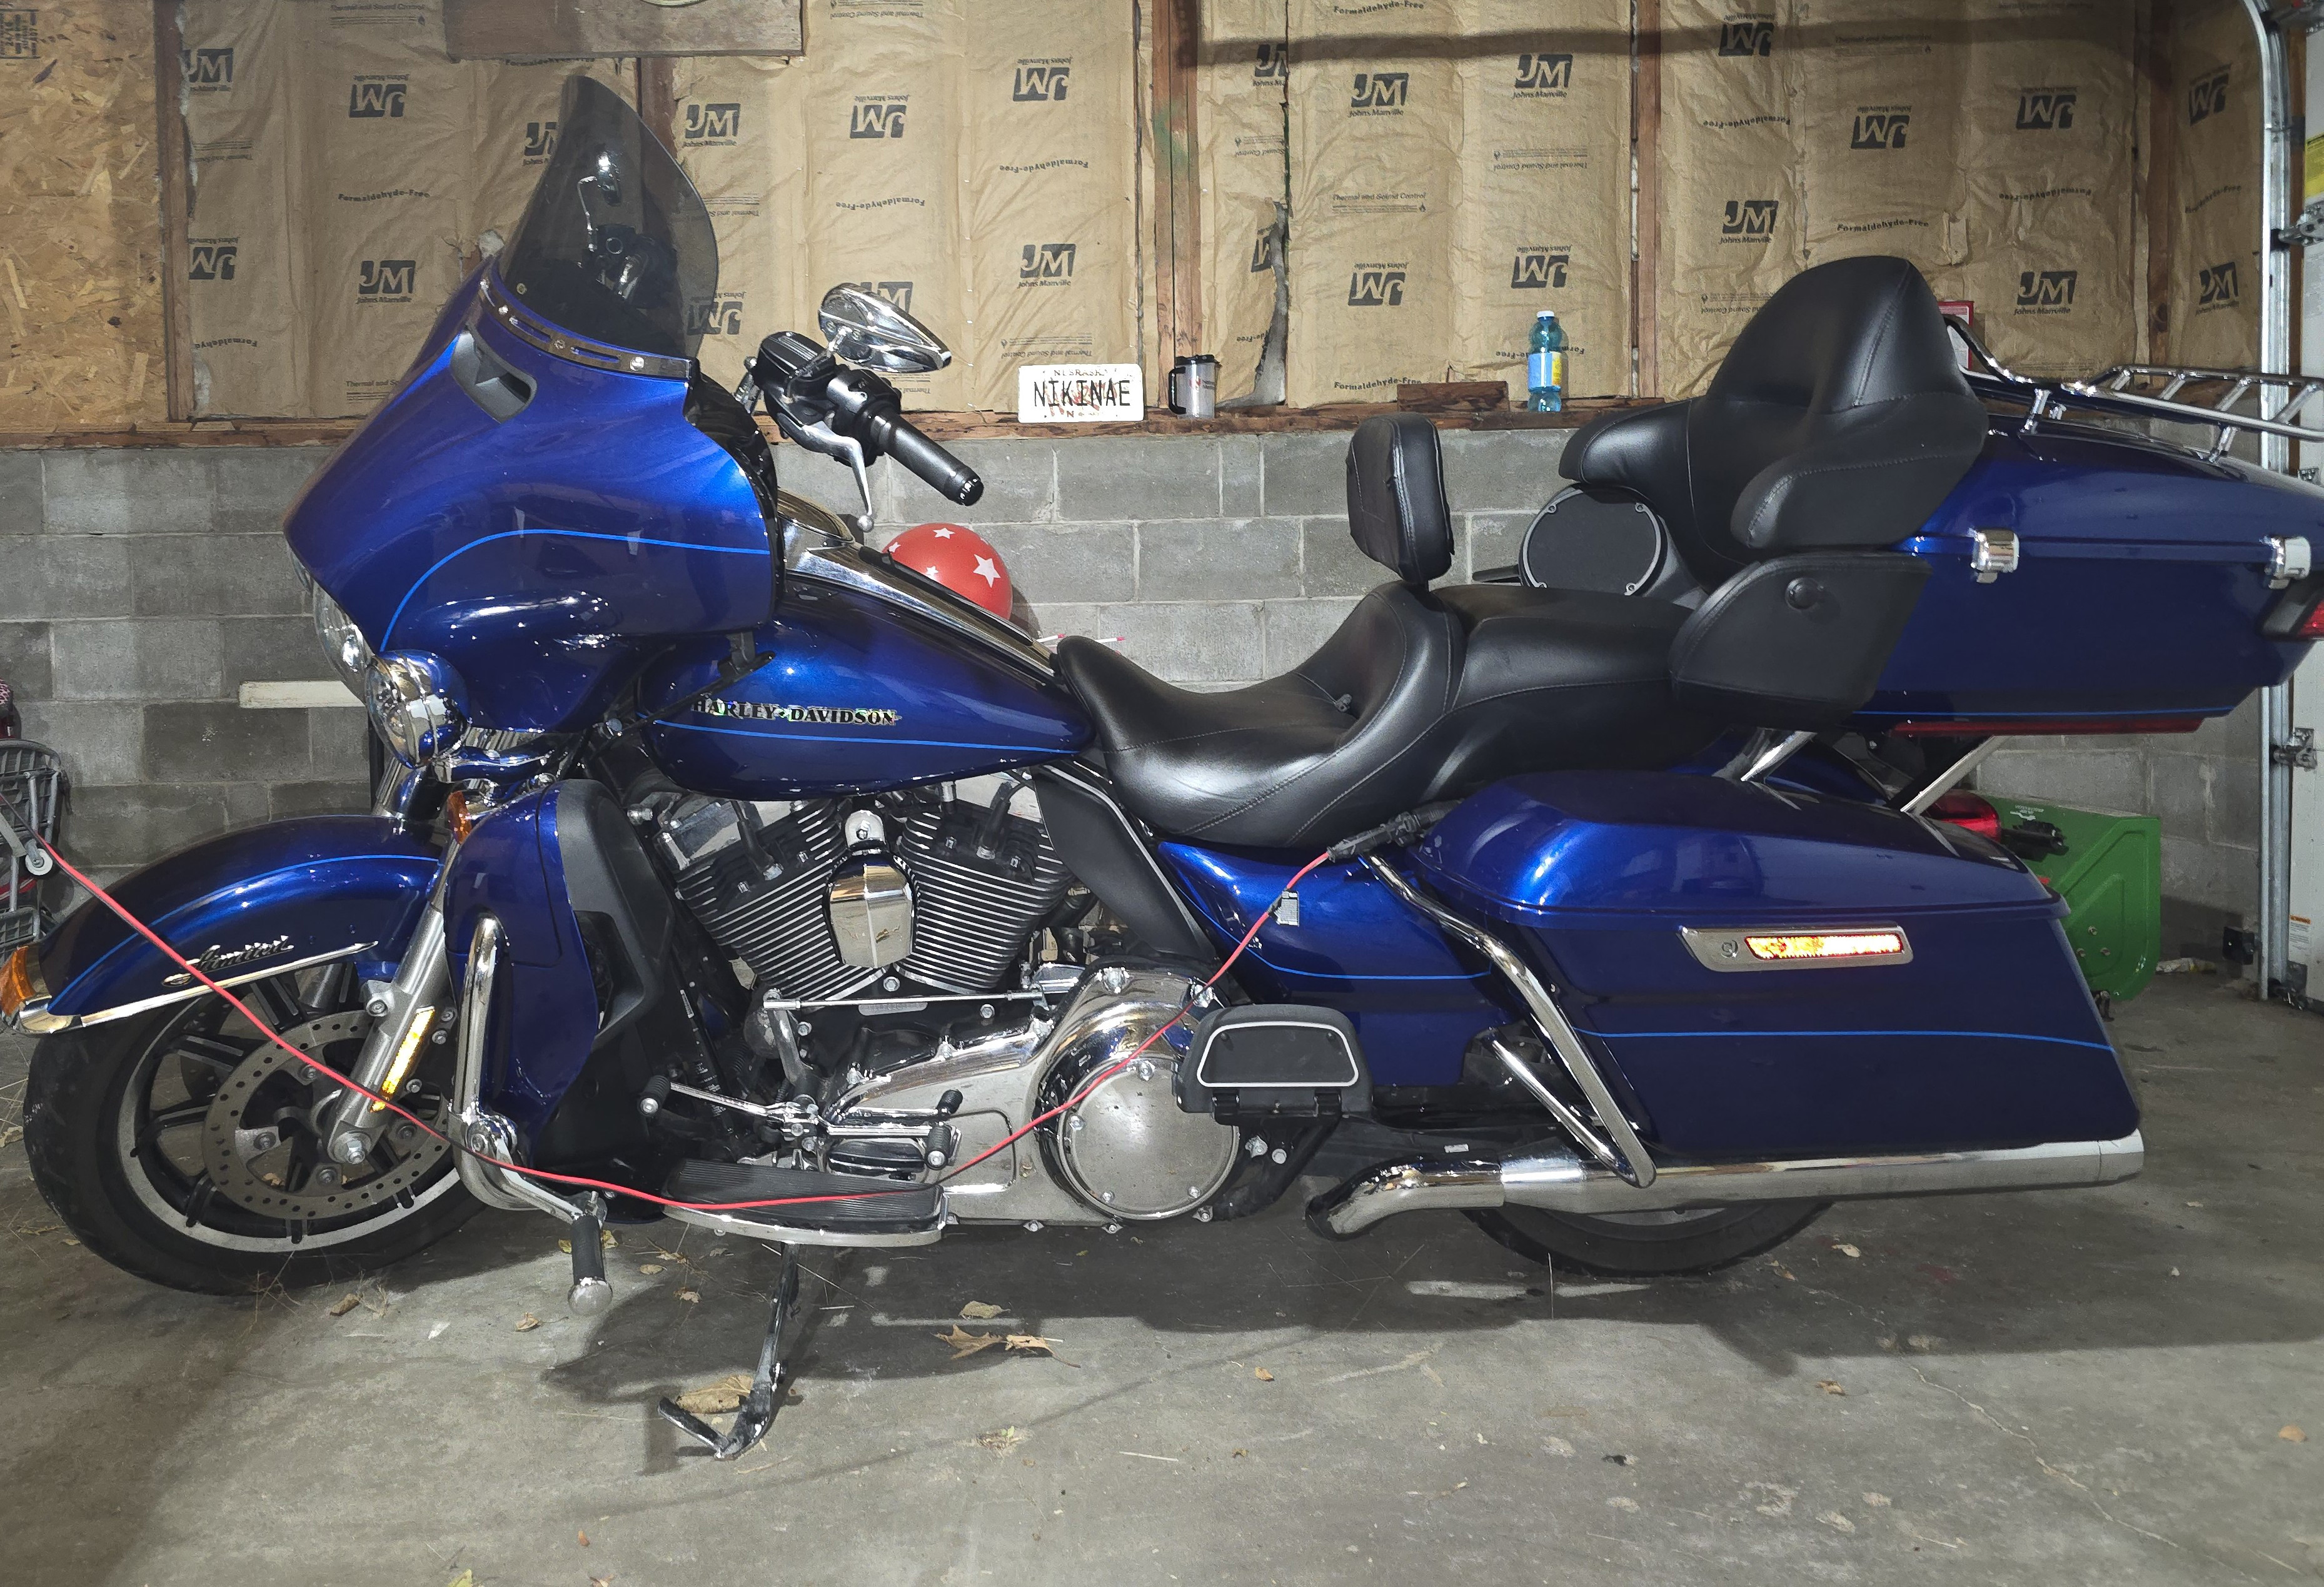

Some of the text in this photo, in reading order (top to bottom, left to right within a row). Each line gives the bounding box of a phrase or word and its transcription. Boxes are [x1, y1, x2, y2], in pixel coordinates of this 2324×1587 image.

[1718, 23, 1774, 56] JM
[1013, 68, 1071, 101] JM
[1515, 54, 1573, 89] JM
[349, 84, 407, 118] JM
[1351, 73, 1409, 108] JM
[685, 103, 740, 138] JM
[850, 104, 907, 139] JM
[2016, 94, 2076, 129] JM
[1850, 115, 1911, 149] JM
[1723, 201, 1779, 234] JM
[360, 260, 416, 295] JM
[1020, 243, 1077, 278] JM
[1511, 254, 1569, 288] JM
[1348, 272, 1406, 306] JM
[2017, 271, 2078, 306] JM
[2199, 261, 2239, 305] JM
[1034, 379, 1131, 407] NIKINAE
